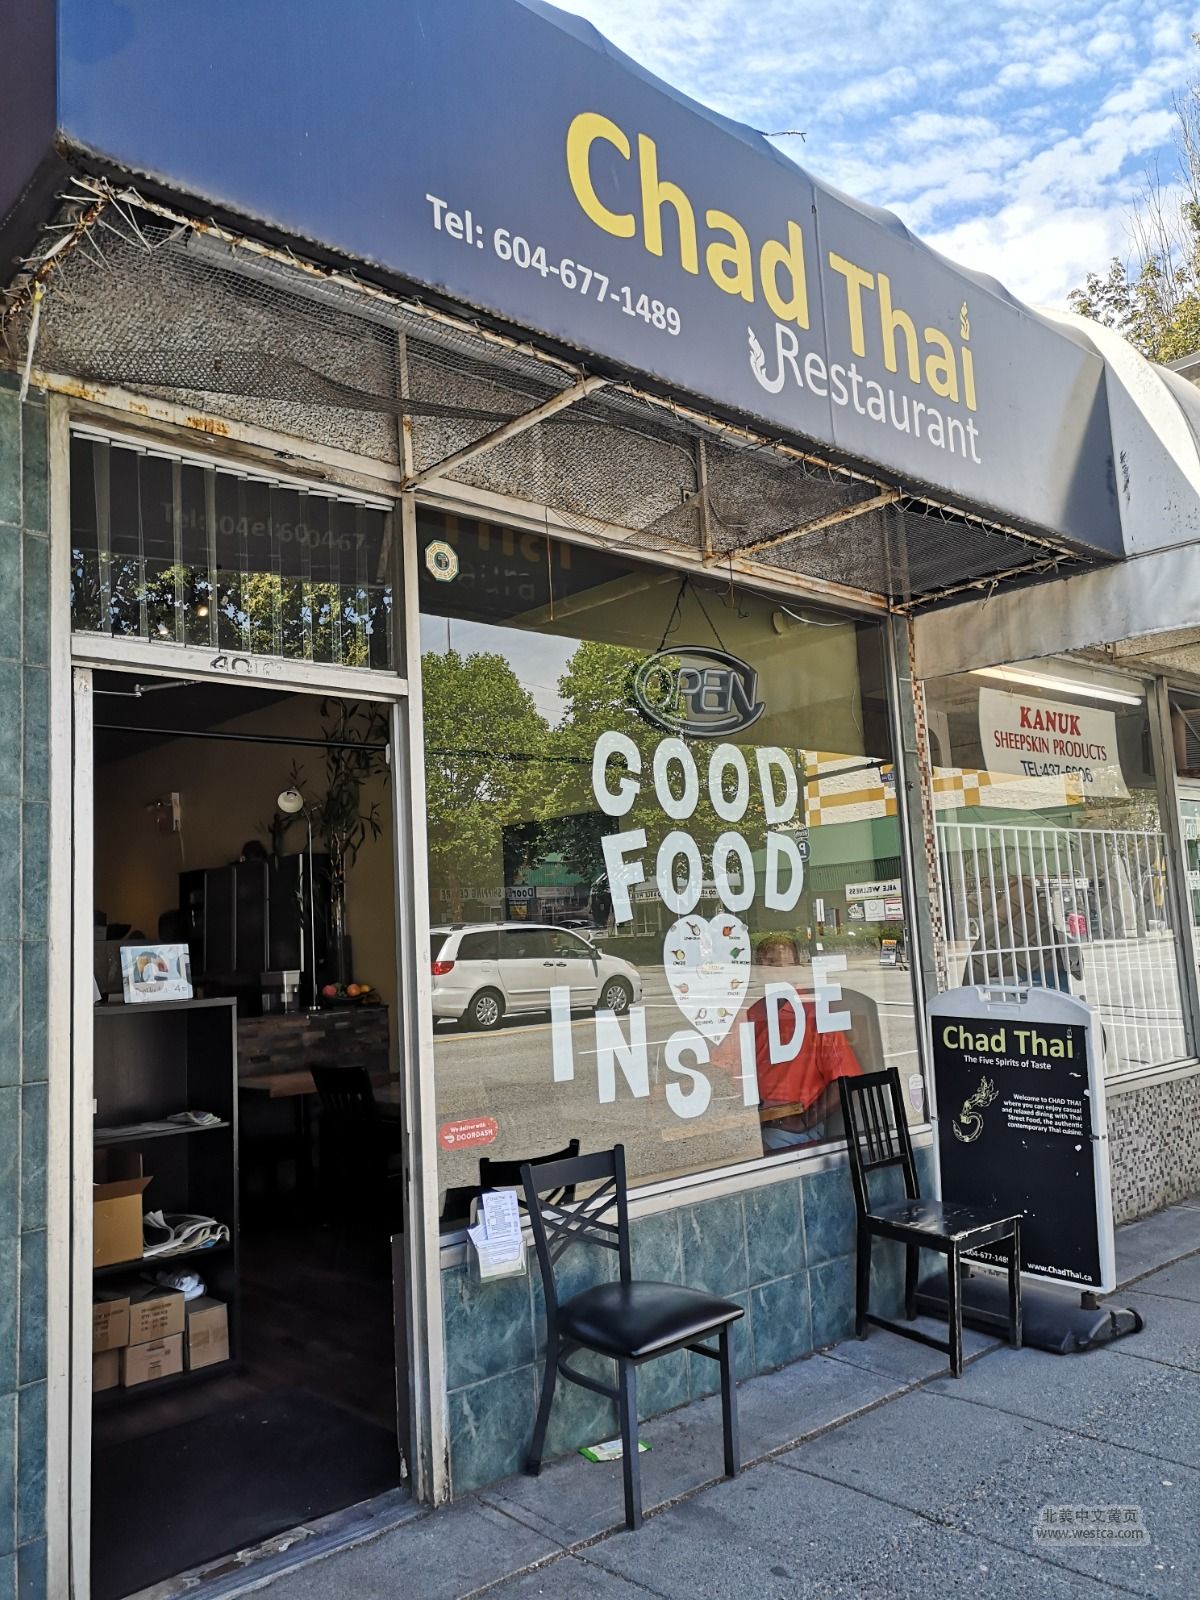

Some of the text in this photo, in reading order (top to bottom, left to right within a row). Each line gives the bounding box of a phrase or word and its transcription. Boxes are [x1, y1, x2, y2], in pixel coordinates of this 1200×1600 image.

[426, 193, 681, 336] Tel: 604-677-1489
[566, 111, 977, 411] Chad Thai
[747, 322, 981, 464] Restaurant
[642, 664, 758, 713] OPEN
[1019, 706, 1082, 736] KANUK
[993, 729, 1107, 762] SHEEPSKIN PRODUCTS
[592, 730, 798, 825] GOOD
[601, 829, 803, 924] FOOD
[550, 954, 852, 1119] INSIDE
[943, 1025, 1073, 1059] Chad Thai
[964, 1055, 1052, 1070] The Five Spirits of Taste
[1013, 1094, 1040, 1102] Welcome
[1048, 1097, 1065, 1105] CHAD
[1067, 1099, 1082, 1107] THAI
[1013, 1108, 1034, 1116] relaxed
[1035, 1110, 1053, 1119] dining
[1063, 1106, 1082, 1114] casual
[456, 1129, 493, 1141] DOORDASH
[459, 1124, 475, 1132] deliver
[1007, 1114, 1025, 1122] Street
[1054, 1120, 1083, 1129] authentic
[1007, 1122, 1047, 1132] contemporary
[1026, 1262, 1093, 1282] www.ChadThai.ca
